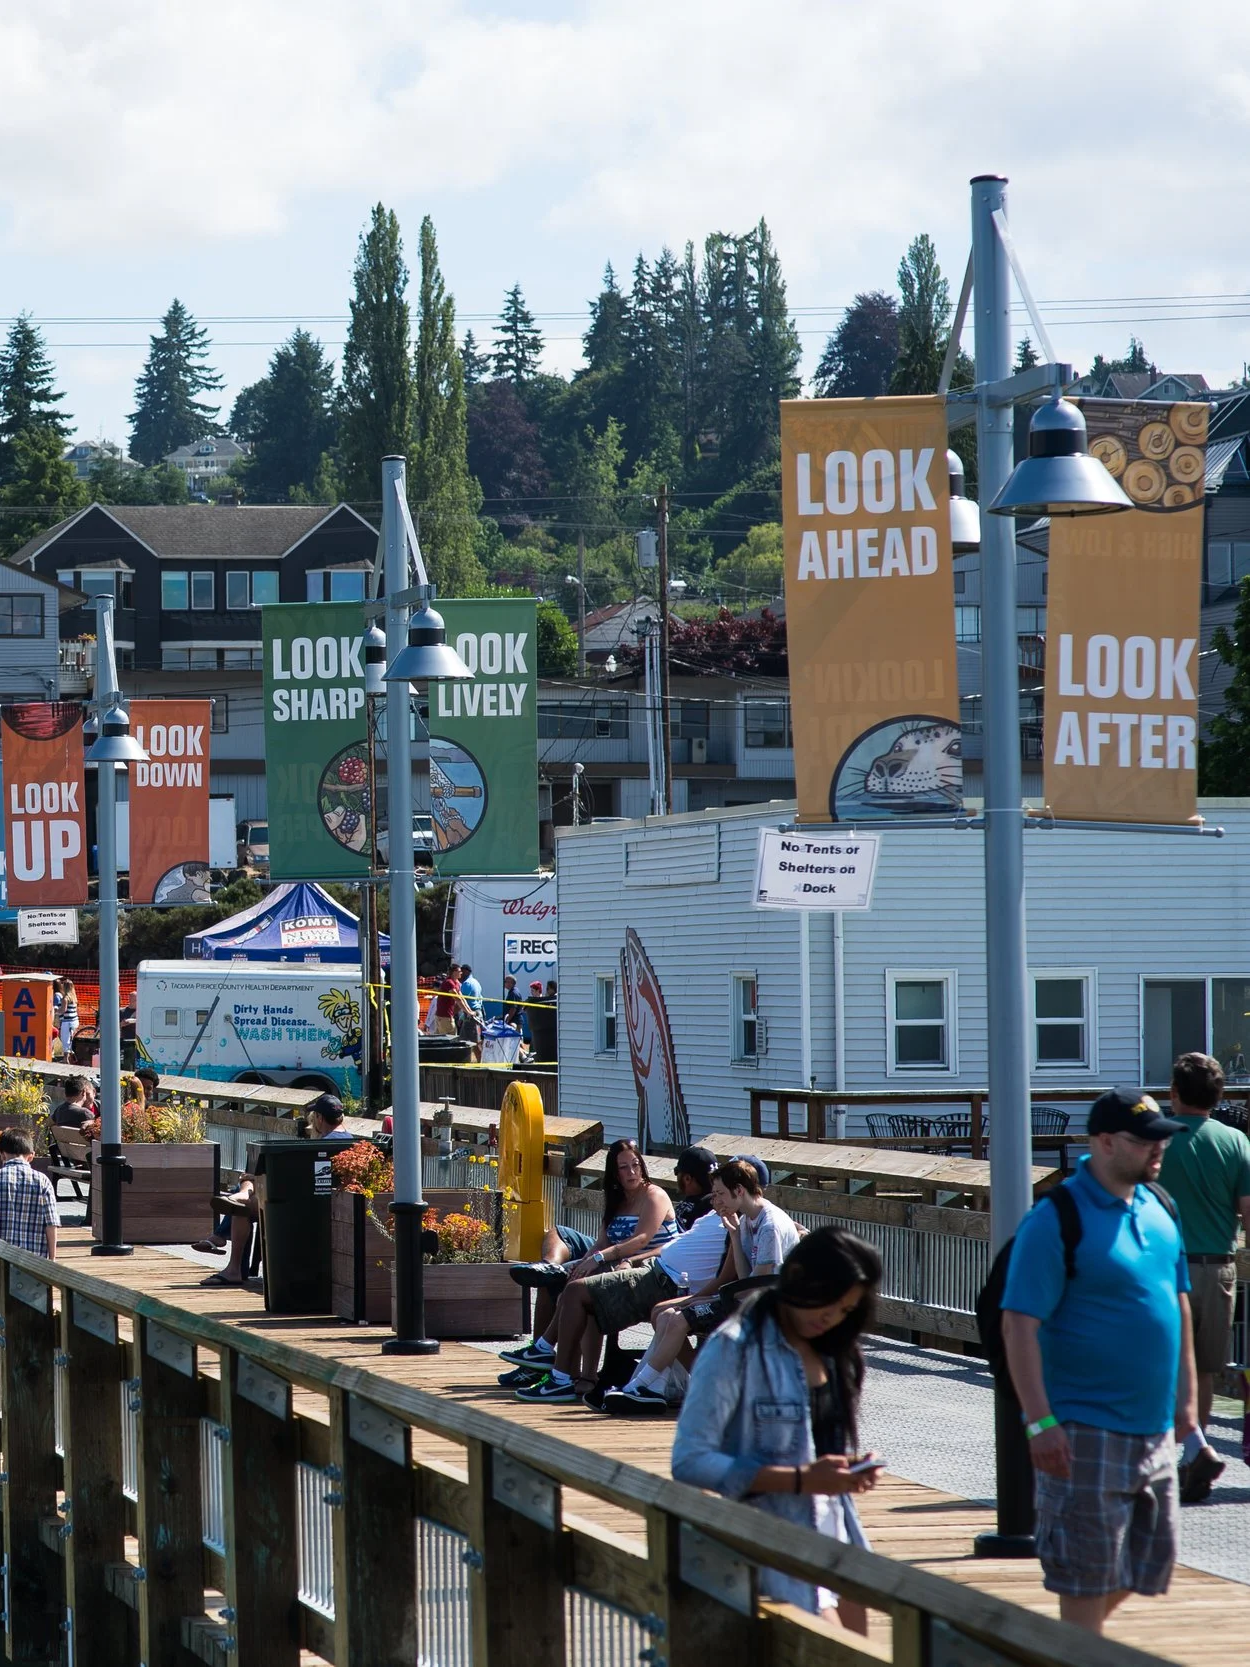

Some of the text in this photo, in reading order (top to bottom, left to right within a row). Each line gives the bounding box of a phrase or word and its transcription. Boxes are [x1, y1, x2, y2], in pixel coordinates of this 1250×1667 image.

[796, 447, 938, 516] LOOK
[797, 526, 939, 581] AHEAD
[272, 636, 365, 680] LOOK
[455, 632, 529, 674] OOK
[1058, 633, 1197, 700] LOOK
[272, 687, 365, 722] SHARP
[437, 682, 528, 718] LIVELY
[136, 725, 204, 757] LOOK
[1054, 711, 1197, 771] AFTER
[136, 762, 203, 788] DOWN
[10, 781, 80, 815] LOOK
[11, 819, 81, 882] UP
[781, 841, 860, 855] No Tents or
[778, 861, 856, 875] Shelters on
[803, 883, 836, 894] Dock
[284, 917, 333, 931] KOMO
[270, 984, 314, 992] DEPARTMENT
[12, 987, 36, 1057] ATM
[234, 1004, 294, 1016] Dirty Hands
[234, 1017, 316, 1028] Spread Disease...
[236, 1027, 283, 1042] WASH
